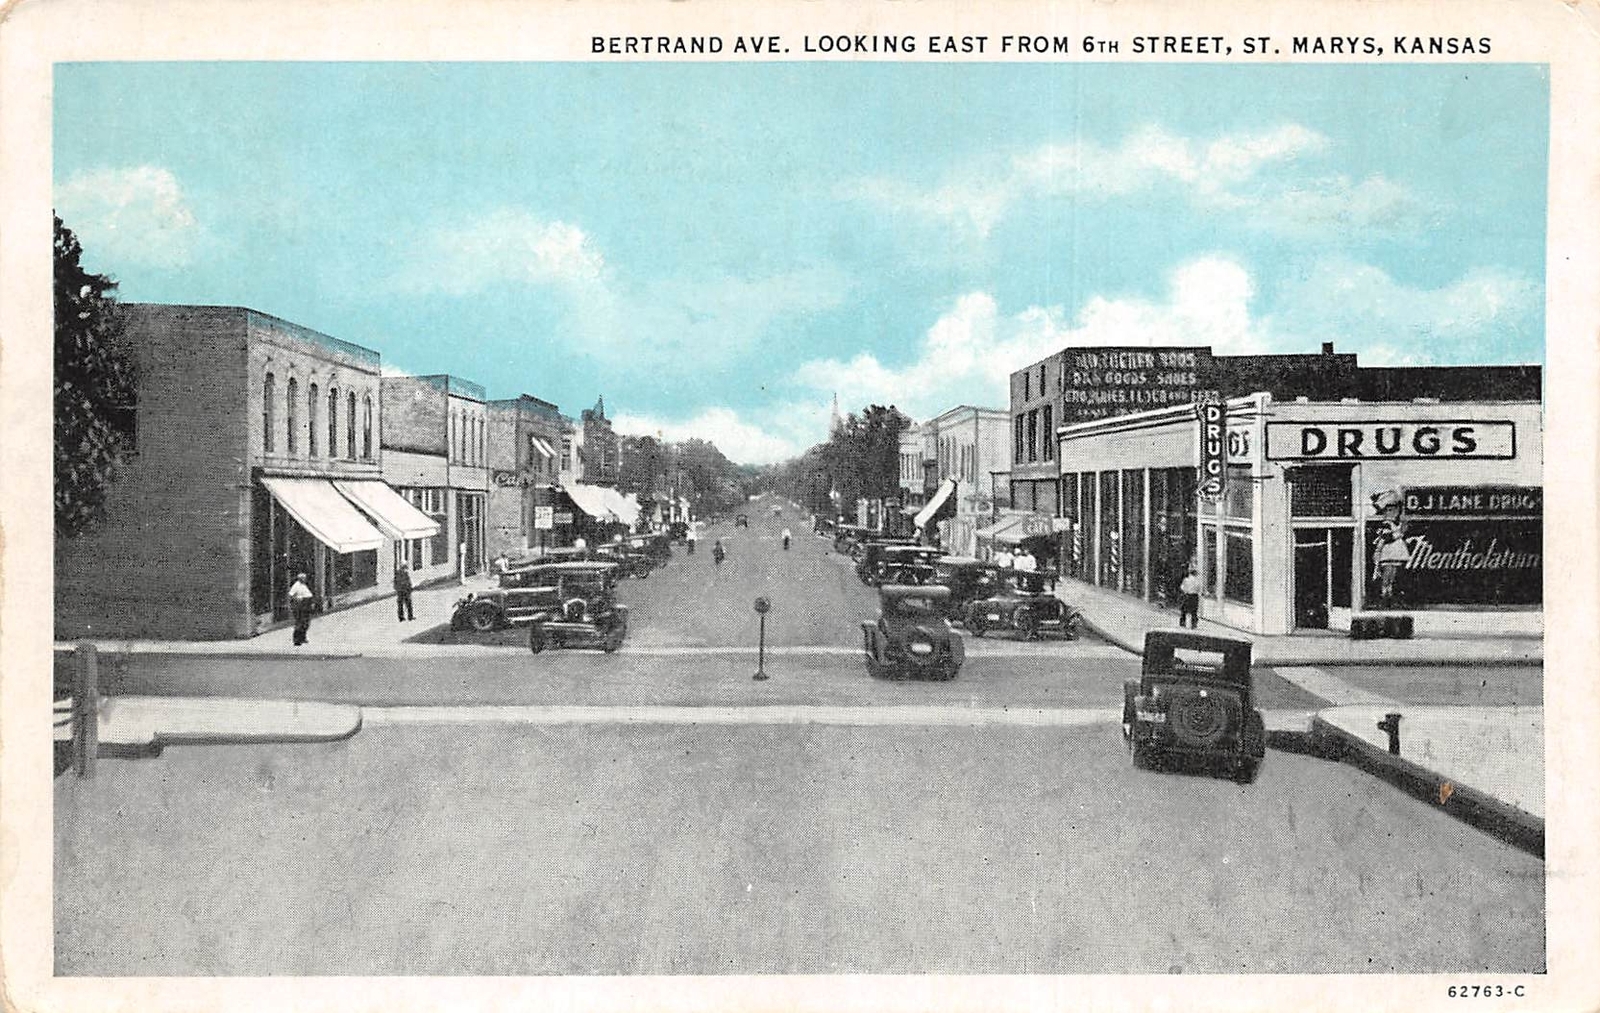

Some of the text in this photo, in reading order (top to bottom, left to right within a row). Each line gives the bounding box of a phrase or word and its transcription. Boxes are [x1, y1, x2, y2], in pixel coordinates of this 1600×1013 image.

[1207, 406, 1221, 492] DRUGS
[1300, 426, 1478, 457] DRUGS
[1438, 495, 1484, 511] LANE
